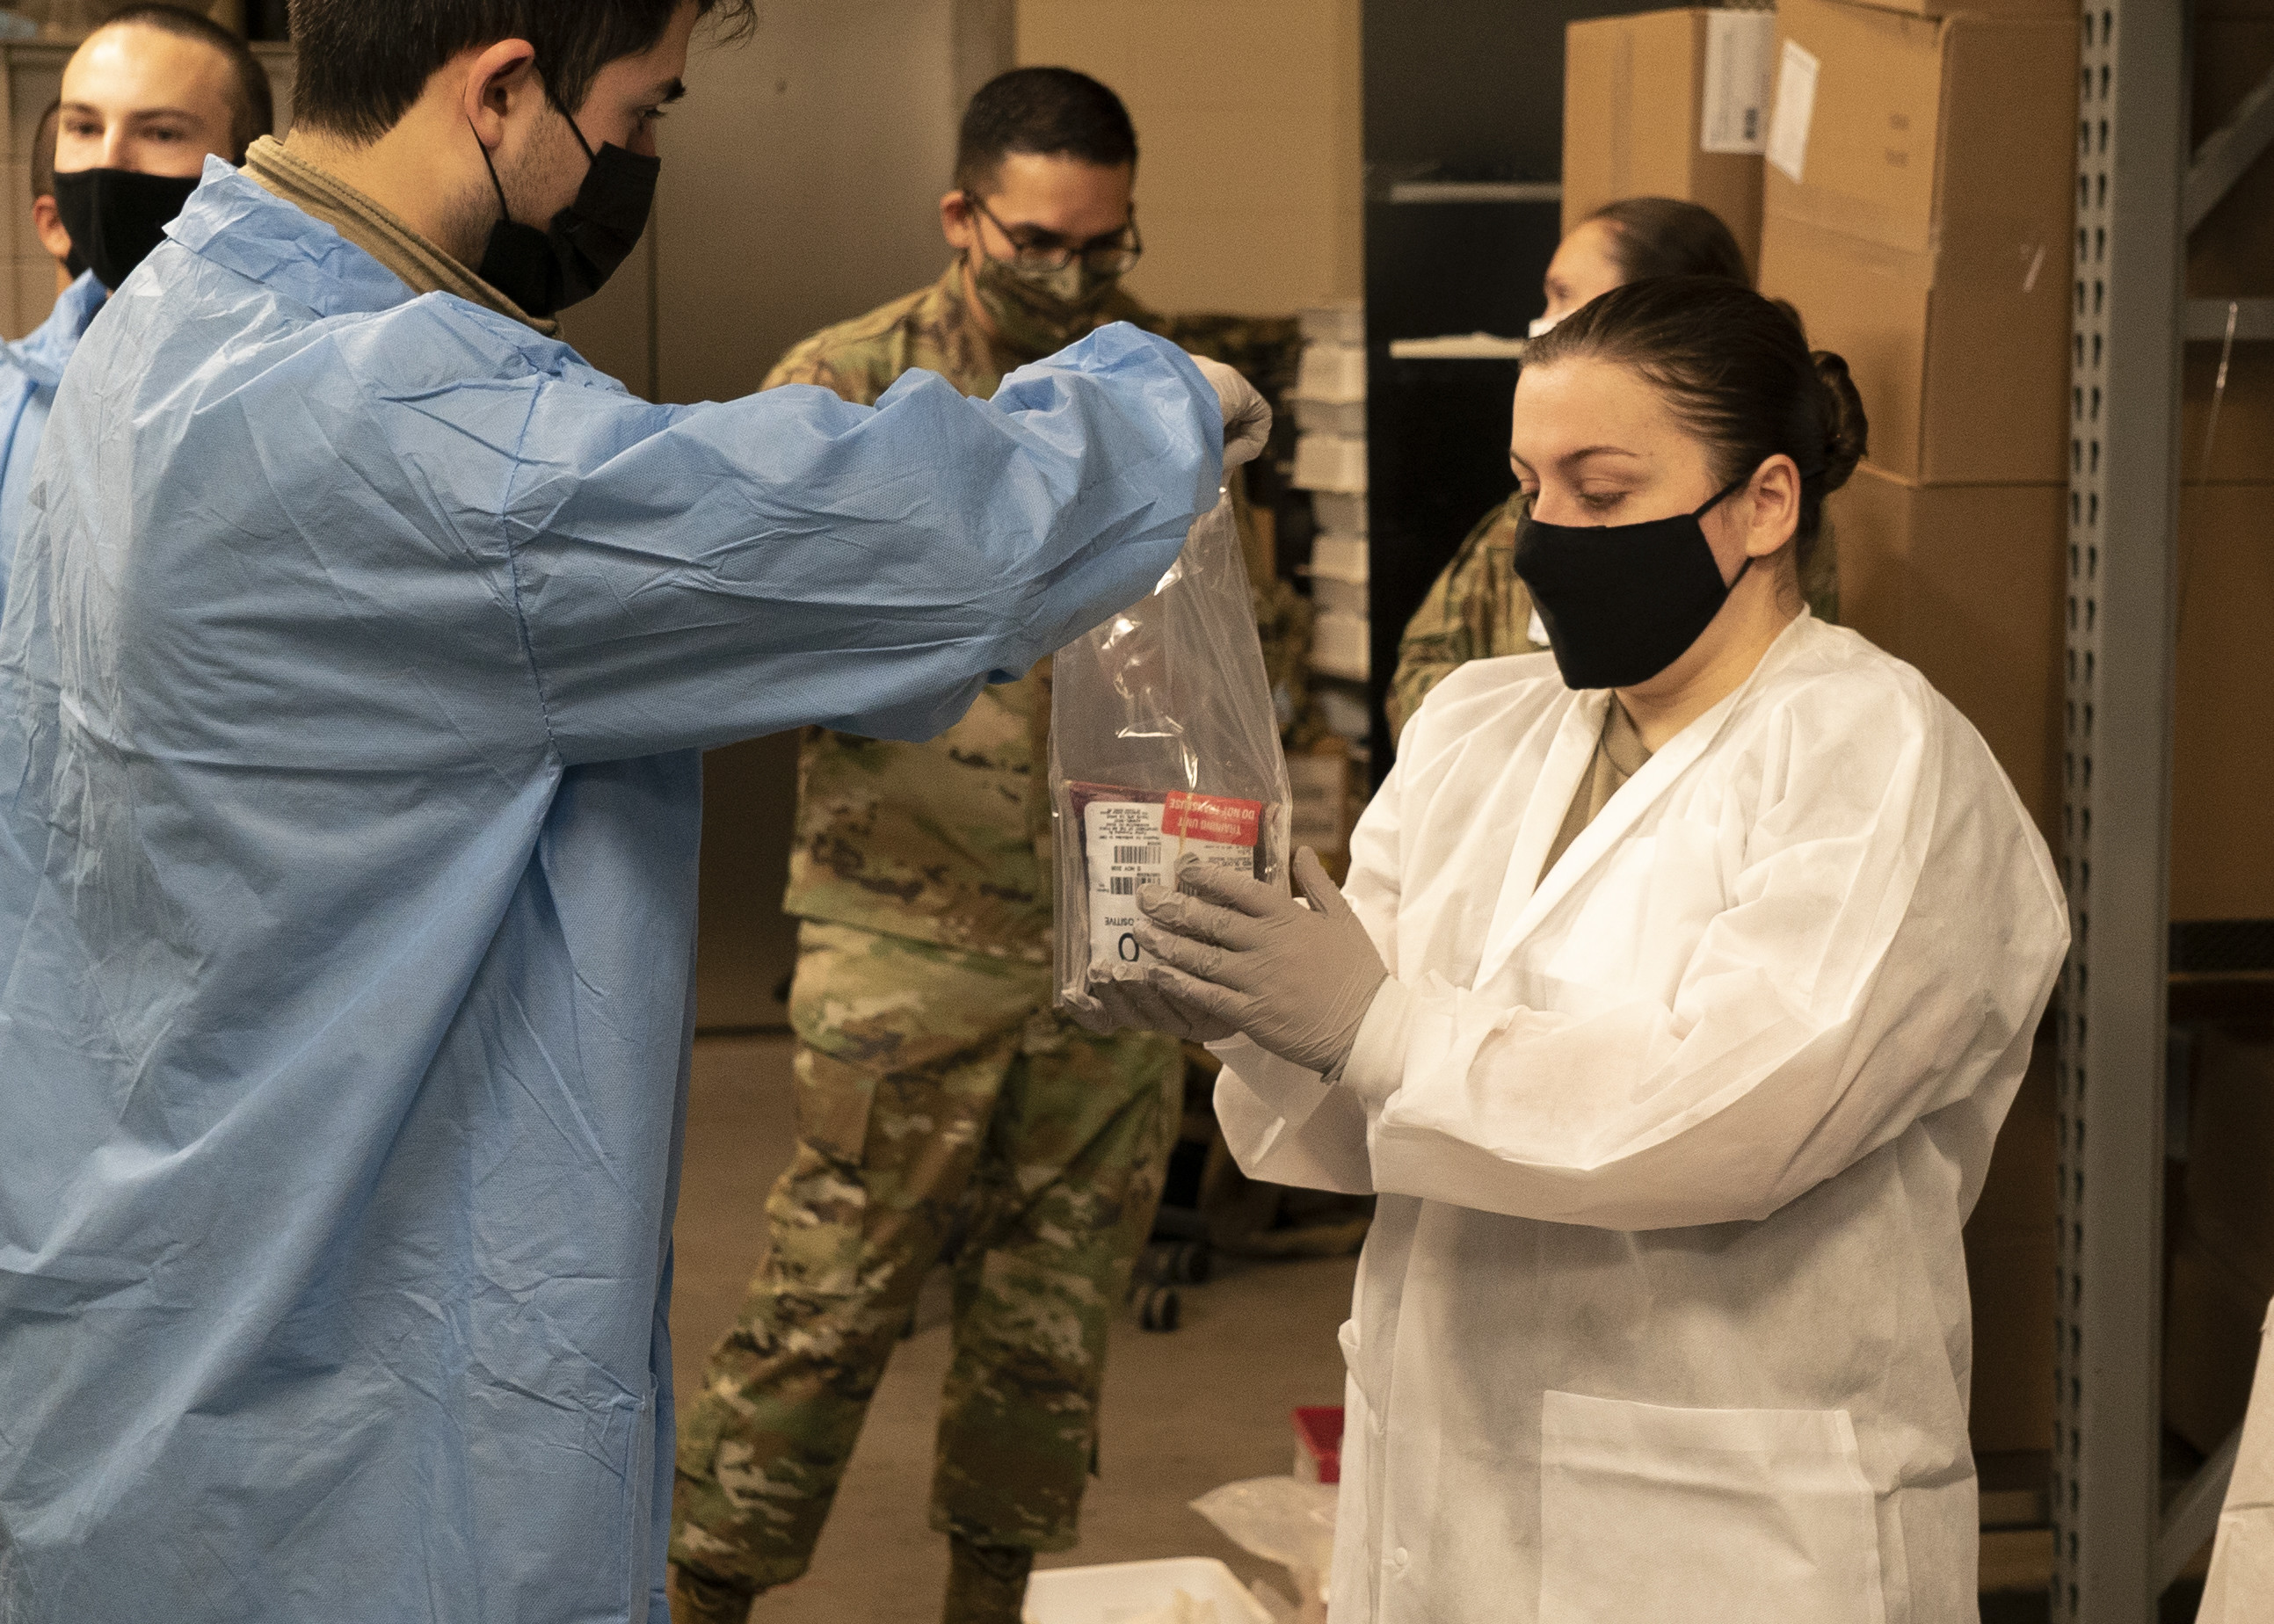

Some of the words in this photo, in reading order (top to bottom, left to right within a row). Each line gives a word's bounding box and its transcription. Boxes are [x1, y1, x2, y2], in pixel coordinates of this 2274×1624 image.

[1168, 798, 1220, 816] TRANSUSE
[1221, 807, 1241, 819] NOT
[1242, 809, 1255, 820] DO
[1200, 819, 1242, 836] TRAINING
[1104, 917, 1140, 926] OSITIVE
[1118, 932, 1140, 962] O
